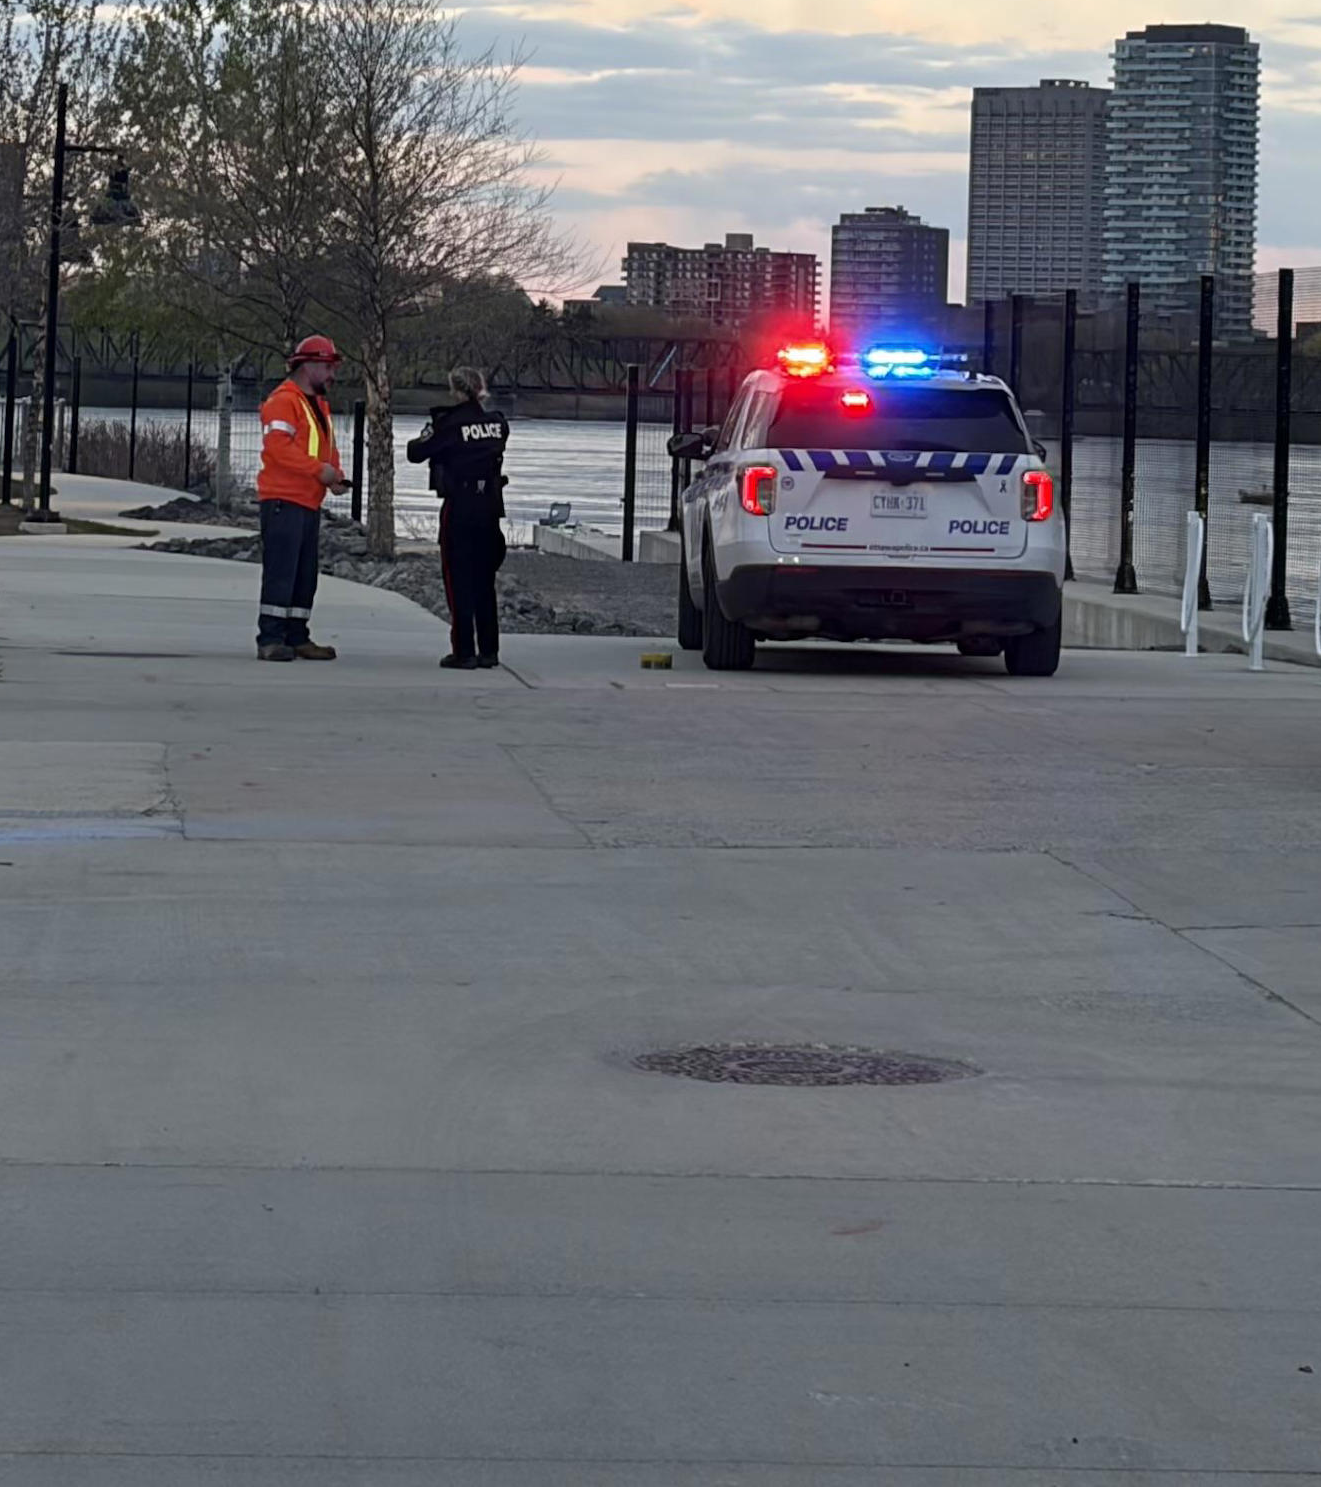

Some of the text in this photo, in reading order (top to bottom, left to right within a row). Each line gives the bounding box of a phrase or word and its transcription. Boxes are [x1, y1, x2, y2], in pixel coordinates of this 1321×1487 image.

[461, 423, 502, 442] POLICE
[784, 516, 849, 531] POLICE
[948, 520, 1010, 535] POLICE
